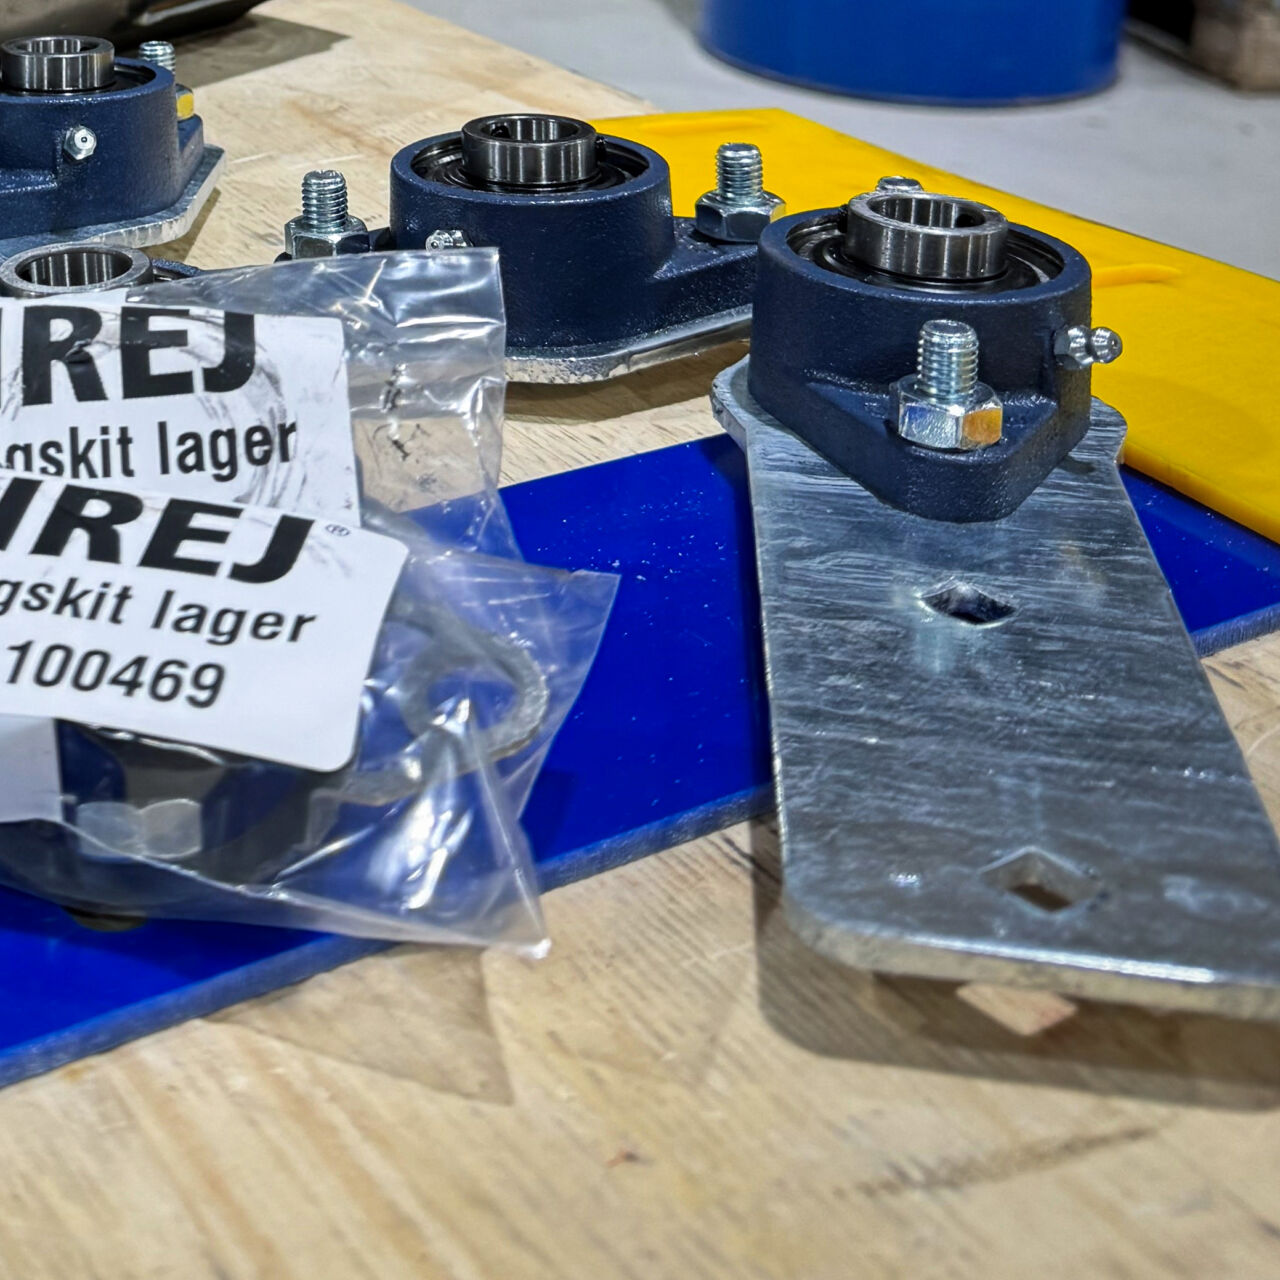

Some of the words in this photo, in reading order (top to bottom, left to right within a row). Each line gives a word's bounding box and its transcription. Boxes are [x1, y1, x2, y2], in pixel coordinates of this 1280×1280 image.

[157, 420, 297, 483] lager
[150, 589, 317, 646] lager
[6, 640, 226, 709] 100469
